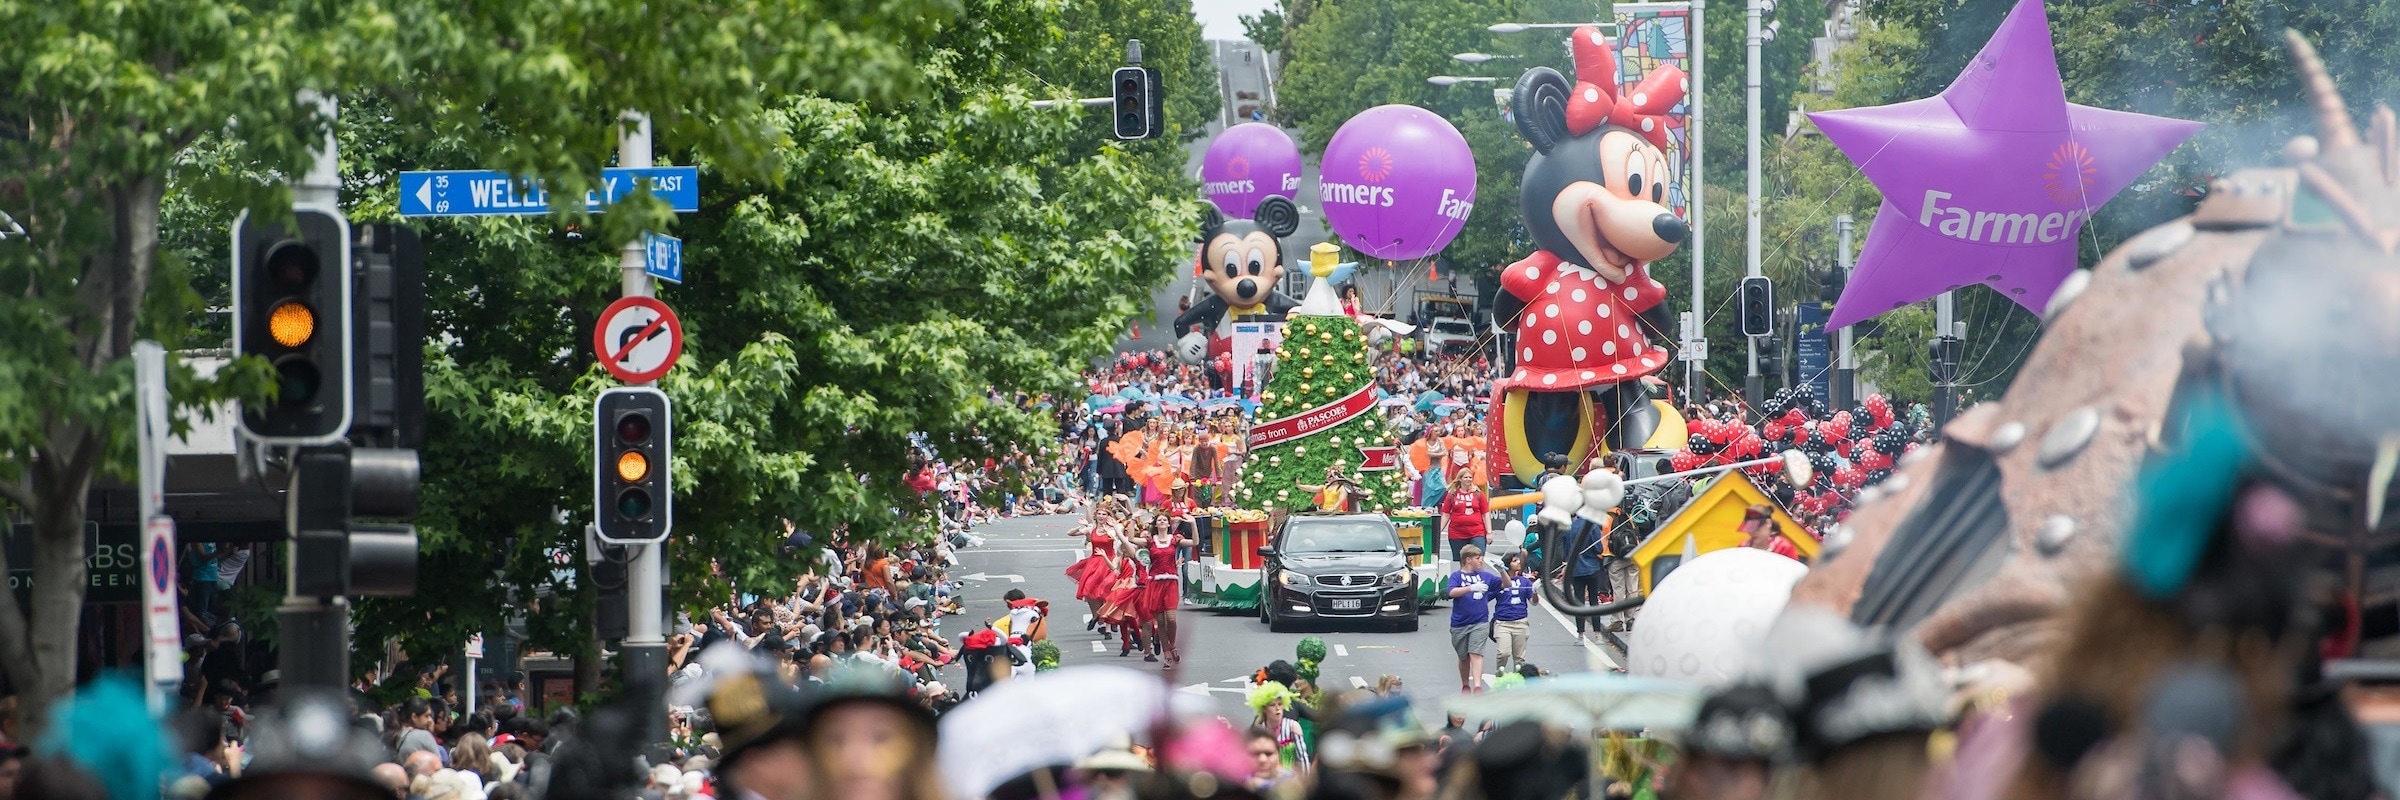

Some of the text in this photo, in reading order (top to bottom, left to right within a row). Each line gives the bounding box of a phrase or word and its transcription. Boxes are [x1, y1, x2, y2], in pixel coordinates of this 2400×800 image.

[435, 175, 449, 189] 35
[1204, 179, 1255, 195] armers
[470, 176, 618, 208] WELLEEY
[651, 175, 683, 192] EAST
[436, 199, 450, 213] 69
[1306, 404, 1348, 425] PASCOES
[1267, 427, 1288, 439] from
